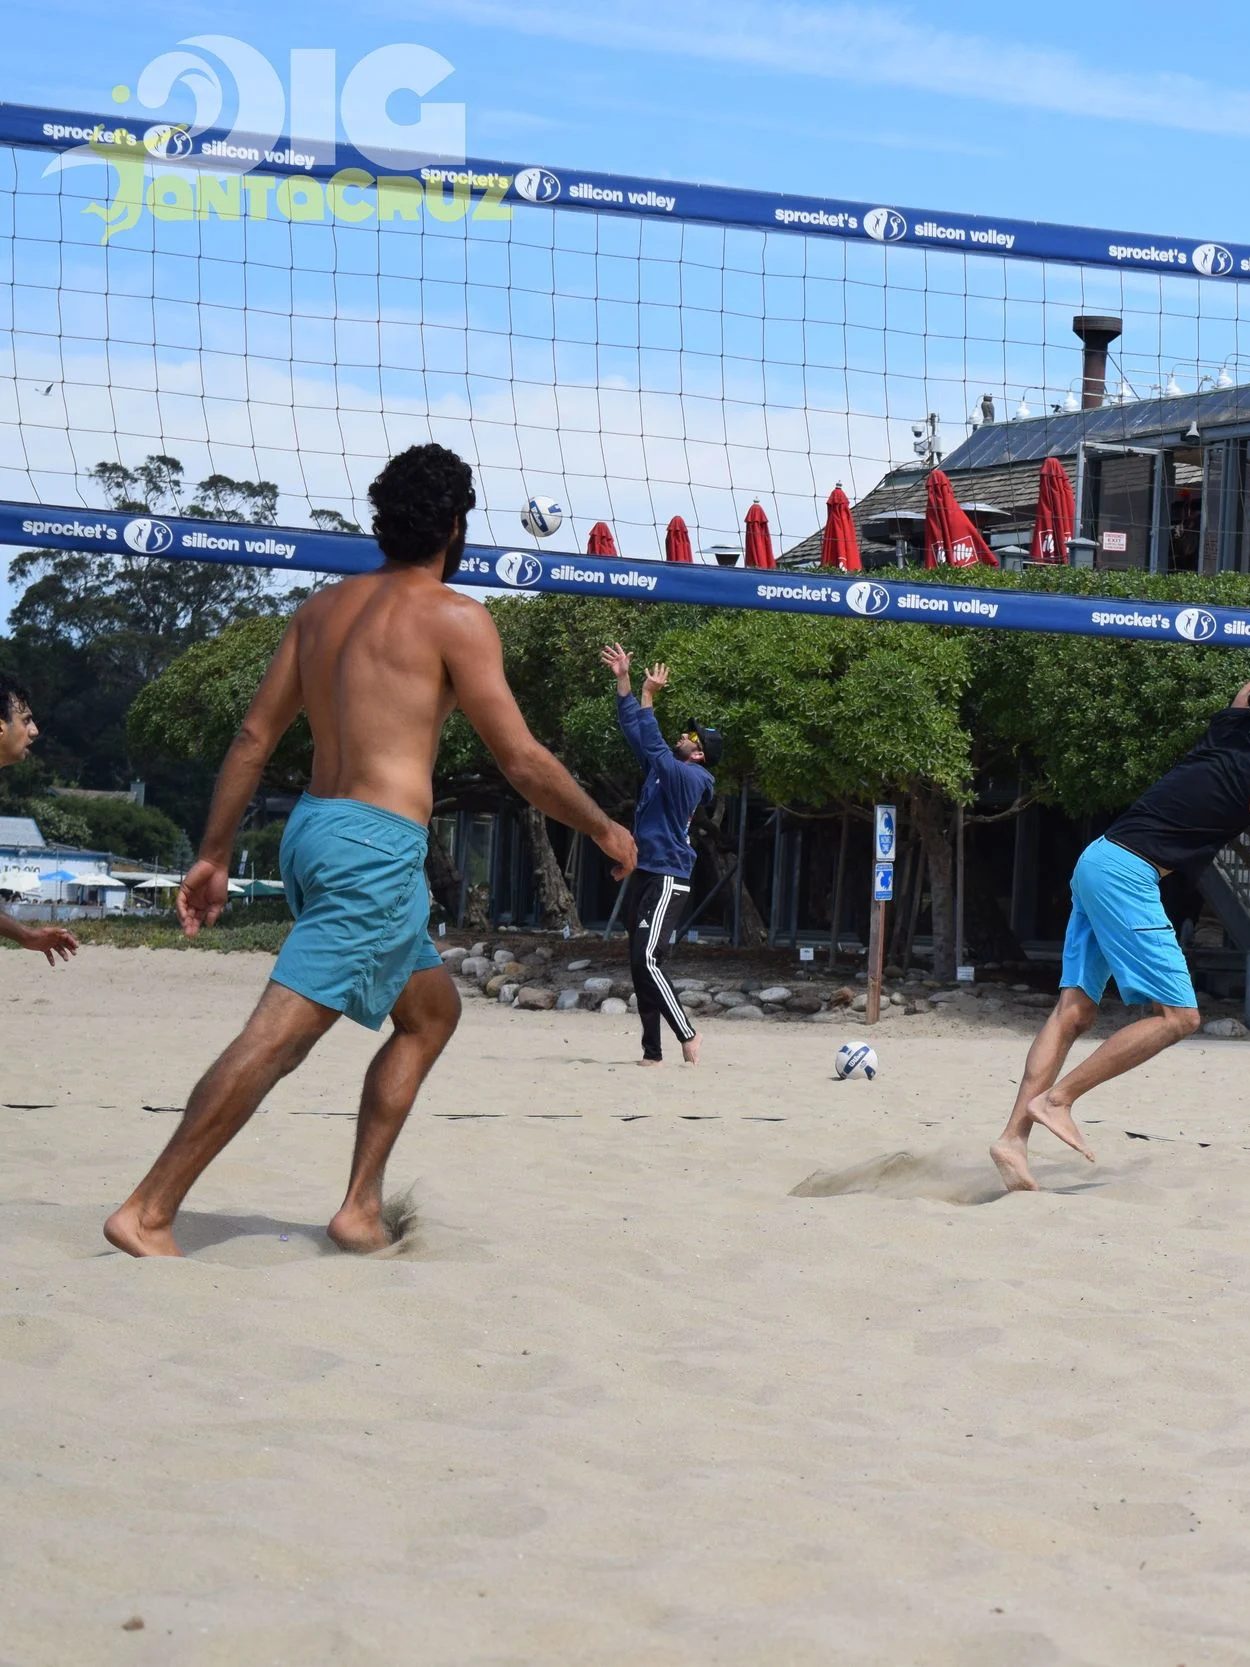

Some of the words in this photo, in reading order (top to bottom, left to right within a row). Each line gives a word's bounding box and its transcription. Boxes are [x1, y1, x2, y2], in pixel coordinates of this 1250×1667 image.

[42, 120, 137, 147] sprocket's
[202, 140, 259, 161] silicon
[264, 147, 315, 170] volley
[420, 165, 509, 190] sprocket's
[569, 182, 624, 203] silicon
[627, 190, 676, 212] volley
[774, 206, 858, 230] sprocket's
[914, 221, 966, 241] silicon
[969, 229, 1015, 249] volley
[1108, 243, 1187, 265] sprocket's
[22, 518, 117, 541] sprocket's
[181, 532, 240, 552] silicon
[244, 538, 296, 559] volley
[550, 564, 605, 584] silicon
[609, 570, 658, 591] volley
[757, 584, 841, 604] sprocket's
[897, 593, 949, 612] silicon
[952, 599, 999, 618] volley
[1091, 611, 1171, 630] sprocket's
